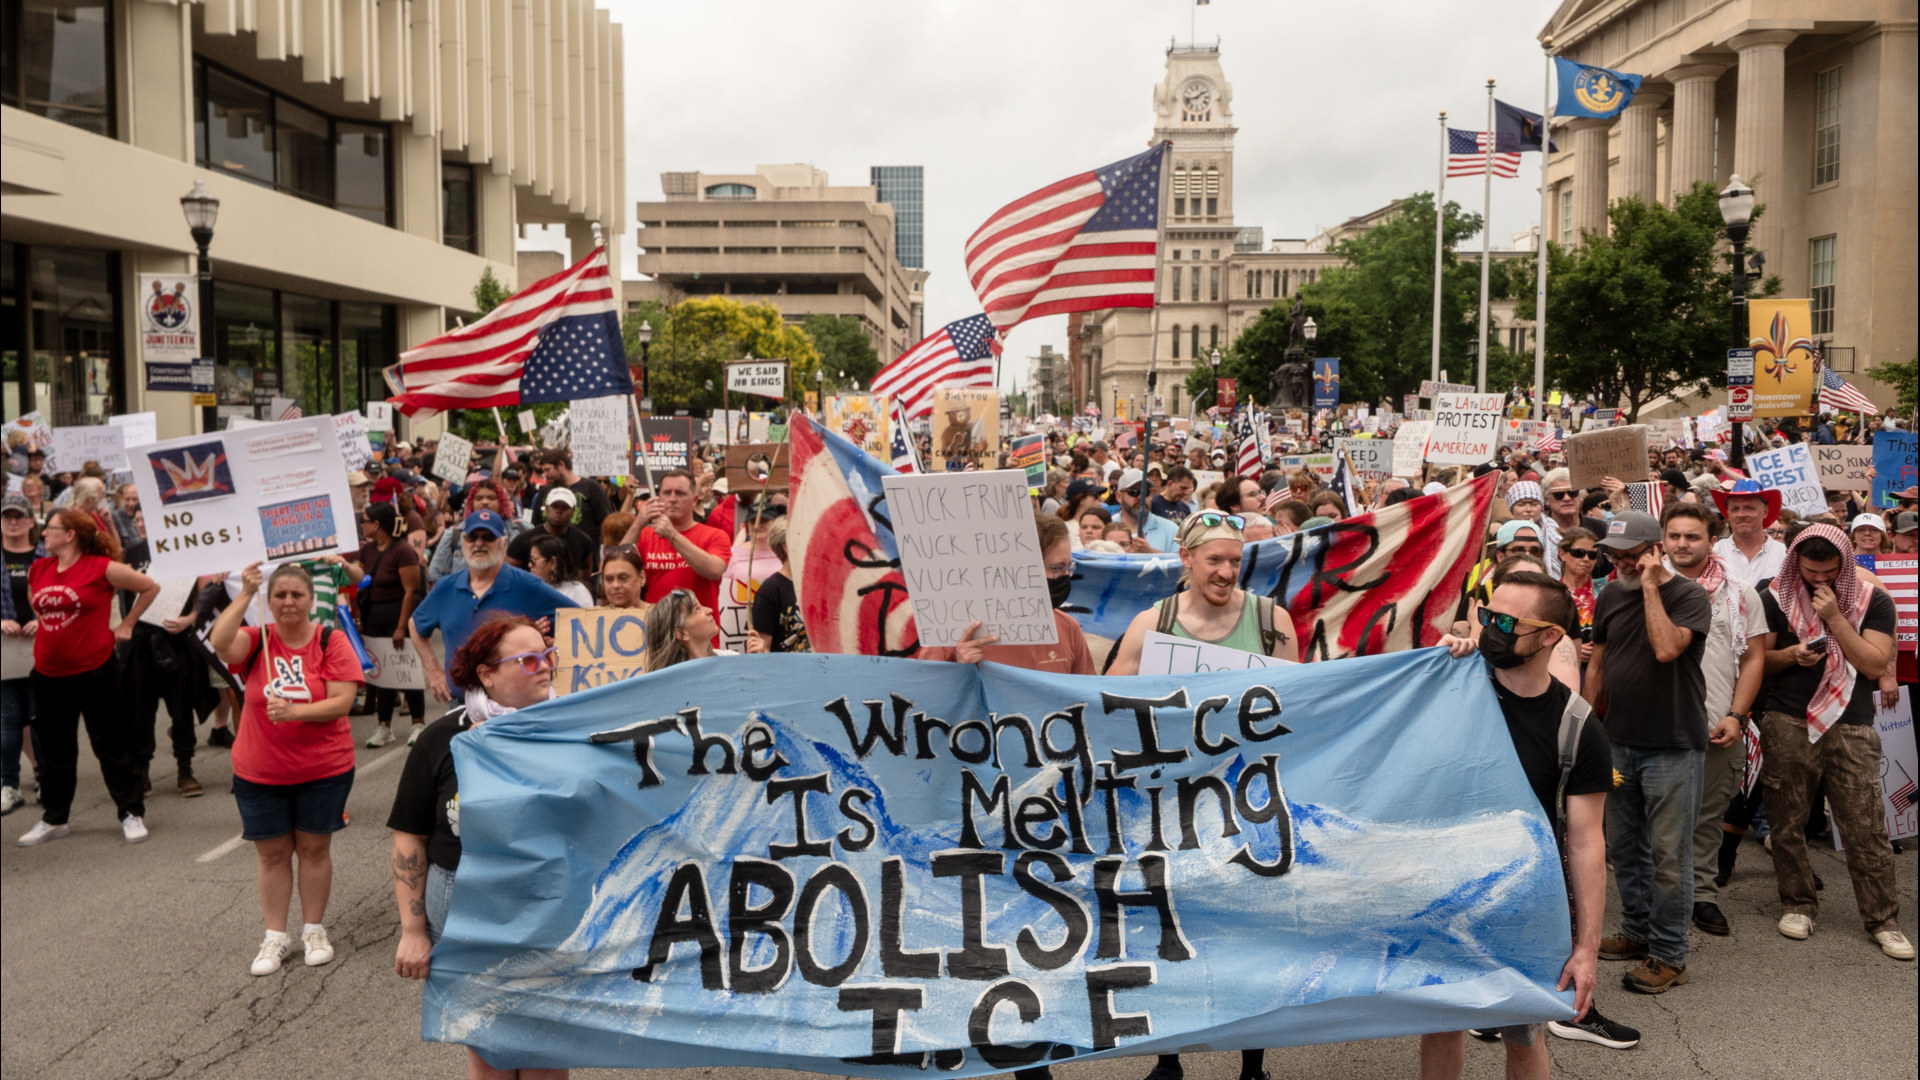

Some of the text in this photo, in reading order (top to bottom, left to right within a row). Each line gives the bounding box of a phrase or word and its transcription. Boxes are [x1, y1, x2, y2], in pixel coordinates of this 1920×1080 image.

[738, 367, 778, 376] WE SAID
[734, 377, 782, 387] NO KINGS
[1455, 397, 1469, 409] LA
[1480, 397, 1504, 411] LOU
[1733, 392, 1748, 400] tarc
[1729, 404, 1752, 412] STOP
[1436, 412, 1500, 430] PROTEST
[64, 431, 117, 448] Silence
[1457, 431, 1468, 441] IS
[653, 442, 687, 452] KINGS
[865, 442, 882, 451] LAND
[960, 450, 996, 458] PREVENT
[1431, 441, 1487, 455] AMERICAN
[1609, 448, 1632, 460] NOT
[636, 456, 687, 466] AMERICA
[1283, 457, 1300, 465] THE
[1752, 447, 1808, 472] ICE IS
[1818, 449, 1873, 467] NO KING
[1759, 467, 1806, 488] BEST
[1821, 464, 1867, 479] NO JOK
[261, 498, 330, 519] THERE ARE NO
[886, 484, 1028, 526] TUCK FRUMP
[164, 511, 193, 528] NO
[272, 509, 324, 528] KINGS IN A
[269, 520, 331, 538] DEMOCRACY
[156, 526, 243, 553] KINGS!
[902, 532, 1033, 560] MUCK FUSK
[646, 552, 674, 561] MAKE
[908, 565, 1043, 592] VUCK FANCE
[915, 597, 1048, 626] RUCK FACISM
[570, 615, 647, 660] NO
[922, 625, 1055, 644] FUC FASCISM
[1879, 716, 1912, 733] Without
[589, 684, 1293, 807] The Wrong Ice
[766, 753, 1296, 877] Is Melting
[632, 850, 1197, 994] ABOLISH
